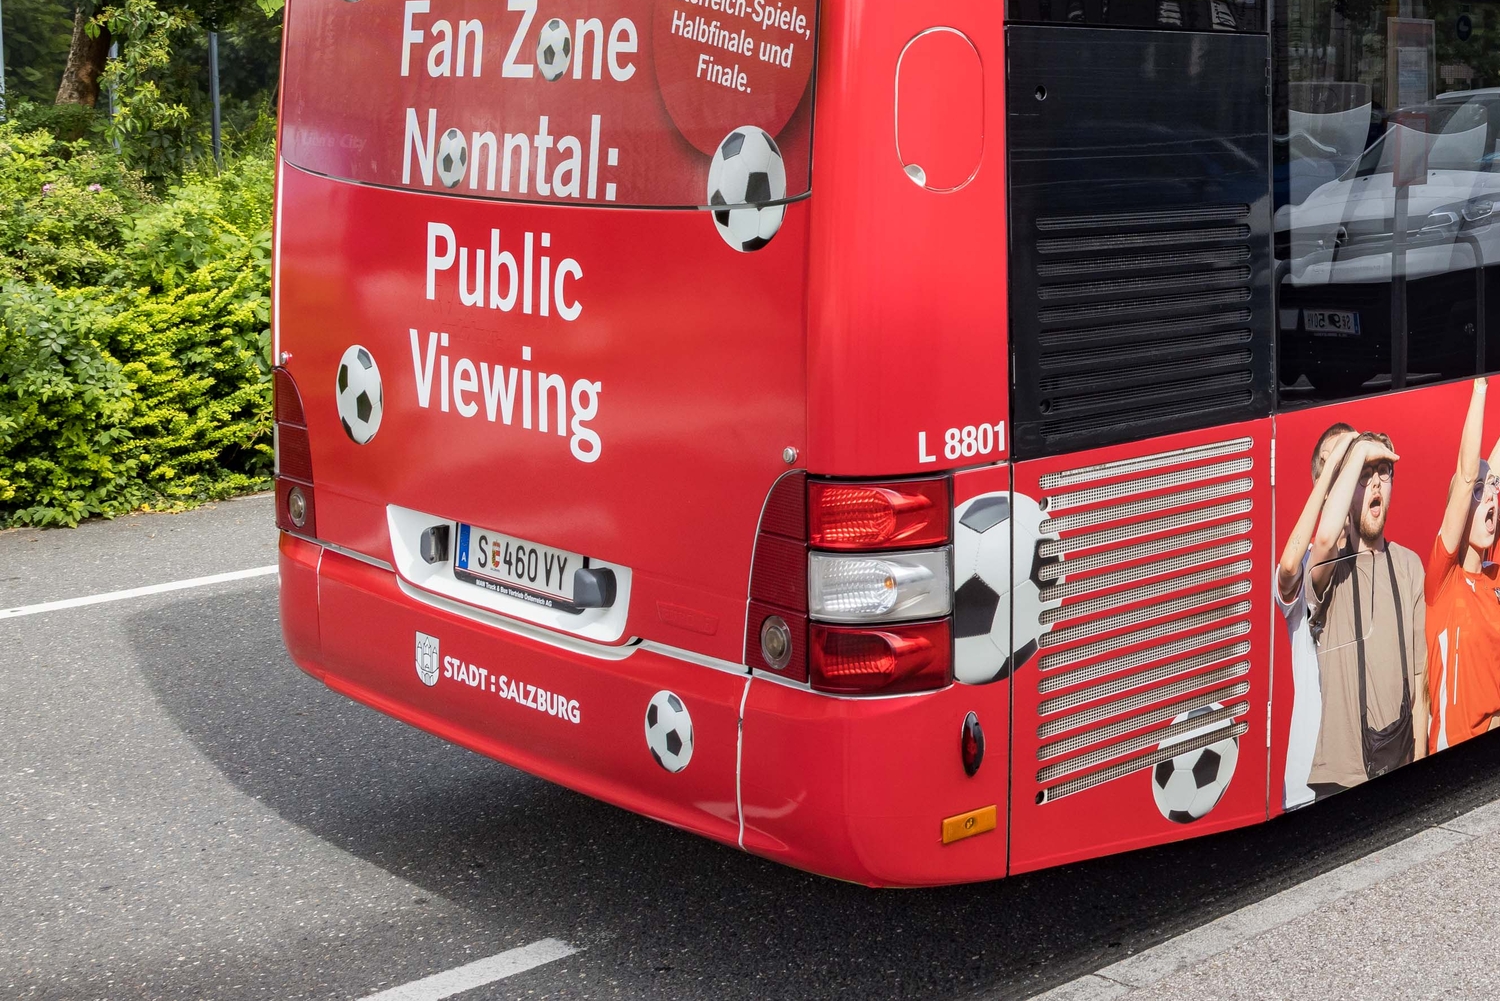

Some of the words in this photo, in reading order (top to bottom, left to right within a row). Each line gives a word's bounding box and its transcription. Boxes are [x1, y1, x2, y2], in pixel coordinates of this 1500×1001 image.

[400, 0, 484, 78] Fan
[671, 10, 754, 59] Halbfinale
[759, 34, 794, 69] und
[696, 53, 753, 94] Finale.
[425, 222, 584, 322] Public
[409, 328, 602, 463] Viewing
[918, 431, 936, 463] L
[944, 420, 1006, 460] 8801
[478, 535, 488, 569] S
[486, 582, 497, 591] Truck
[500, 586, 508, 595] Bus
[508, 589, 524, 599] Vertrieb
[524, 592, 545, 605] Österreich
[443, 656, 488, 690] STADT
[499, 675, 581, 724] SALZBURG
